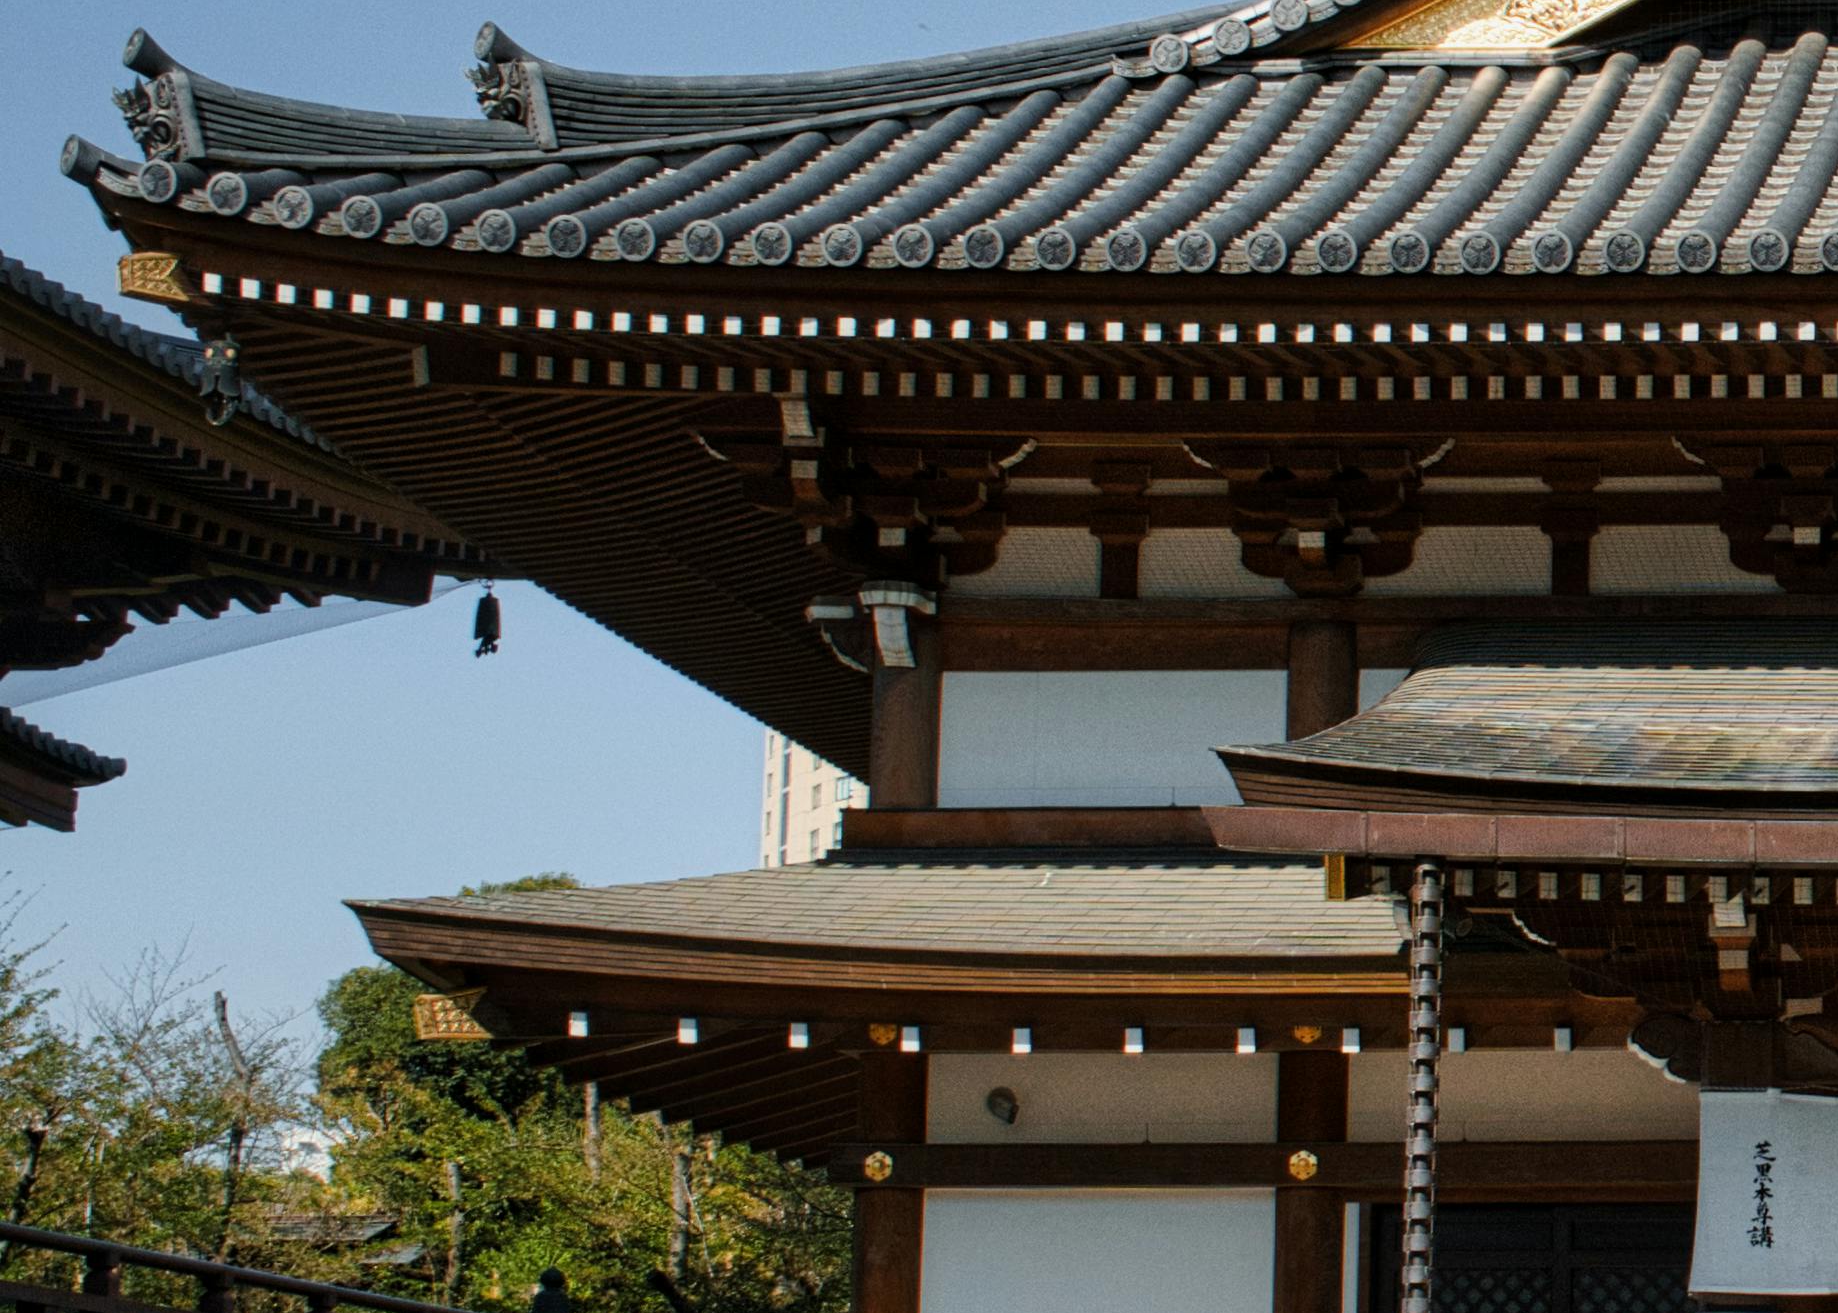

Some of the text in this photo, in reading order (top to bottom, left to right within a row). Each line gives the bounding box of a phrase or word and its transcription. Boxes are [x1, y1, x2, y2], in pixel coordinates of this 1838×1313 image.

[1746, 1140, 1777, 1249] 芝黒本尊講
